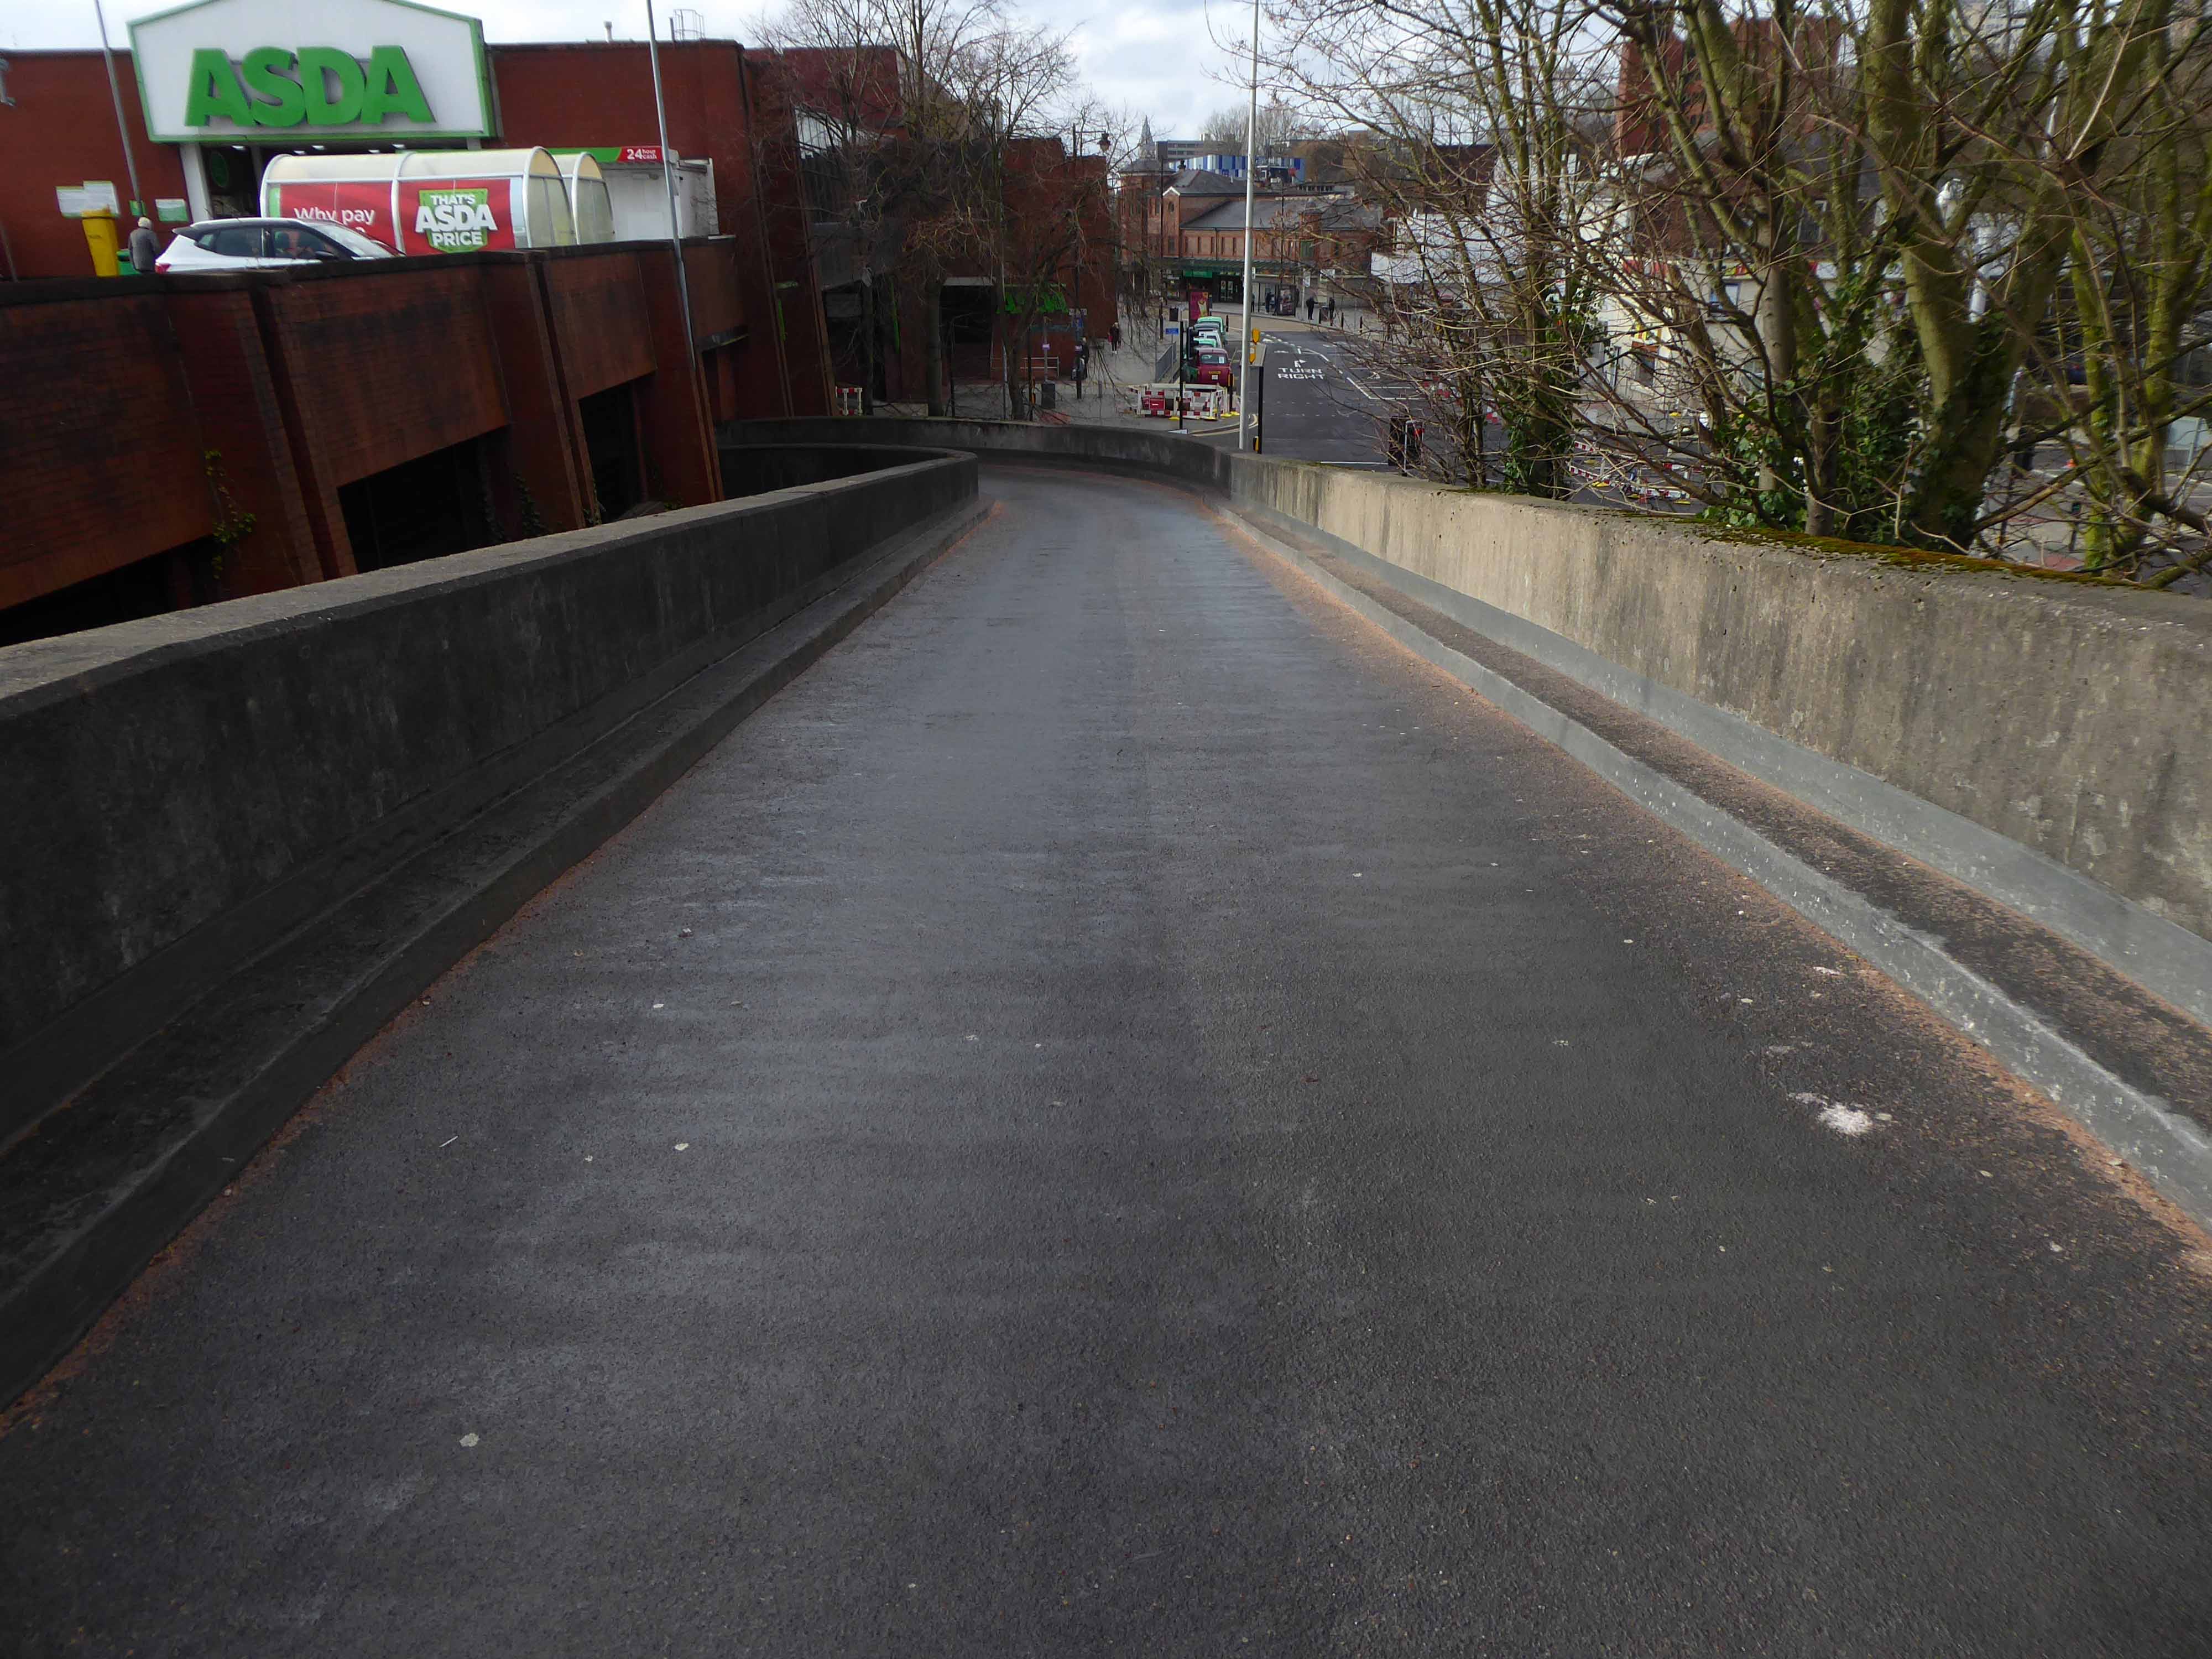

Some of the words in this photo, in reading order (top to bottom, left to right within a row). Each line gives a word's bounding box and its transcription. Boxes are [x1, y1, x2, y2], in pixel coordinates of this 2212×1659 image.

[185, 46, 436, 128] ASDA
[627, 148, 643, 160] 24
[430, 194, 476, 205] THAT'S
[293, 207, 337, 221] Why
[341, 209, 375, 226] pay
[415, 204, 498, 233] ASDA
[431, 231, 484, 247] PRICE
